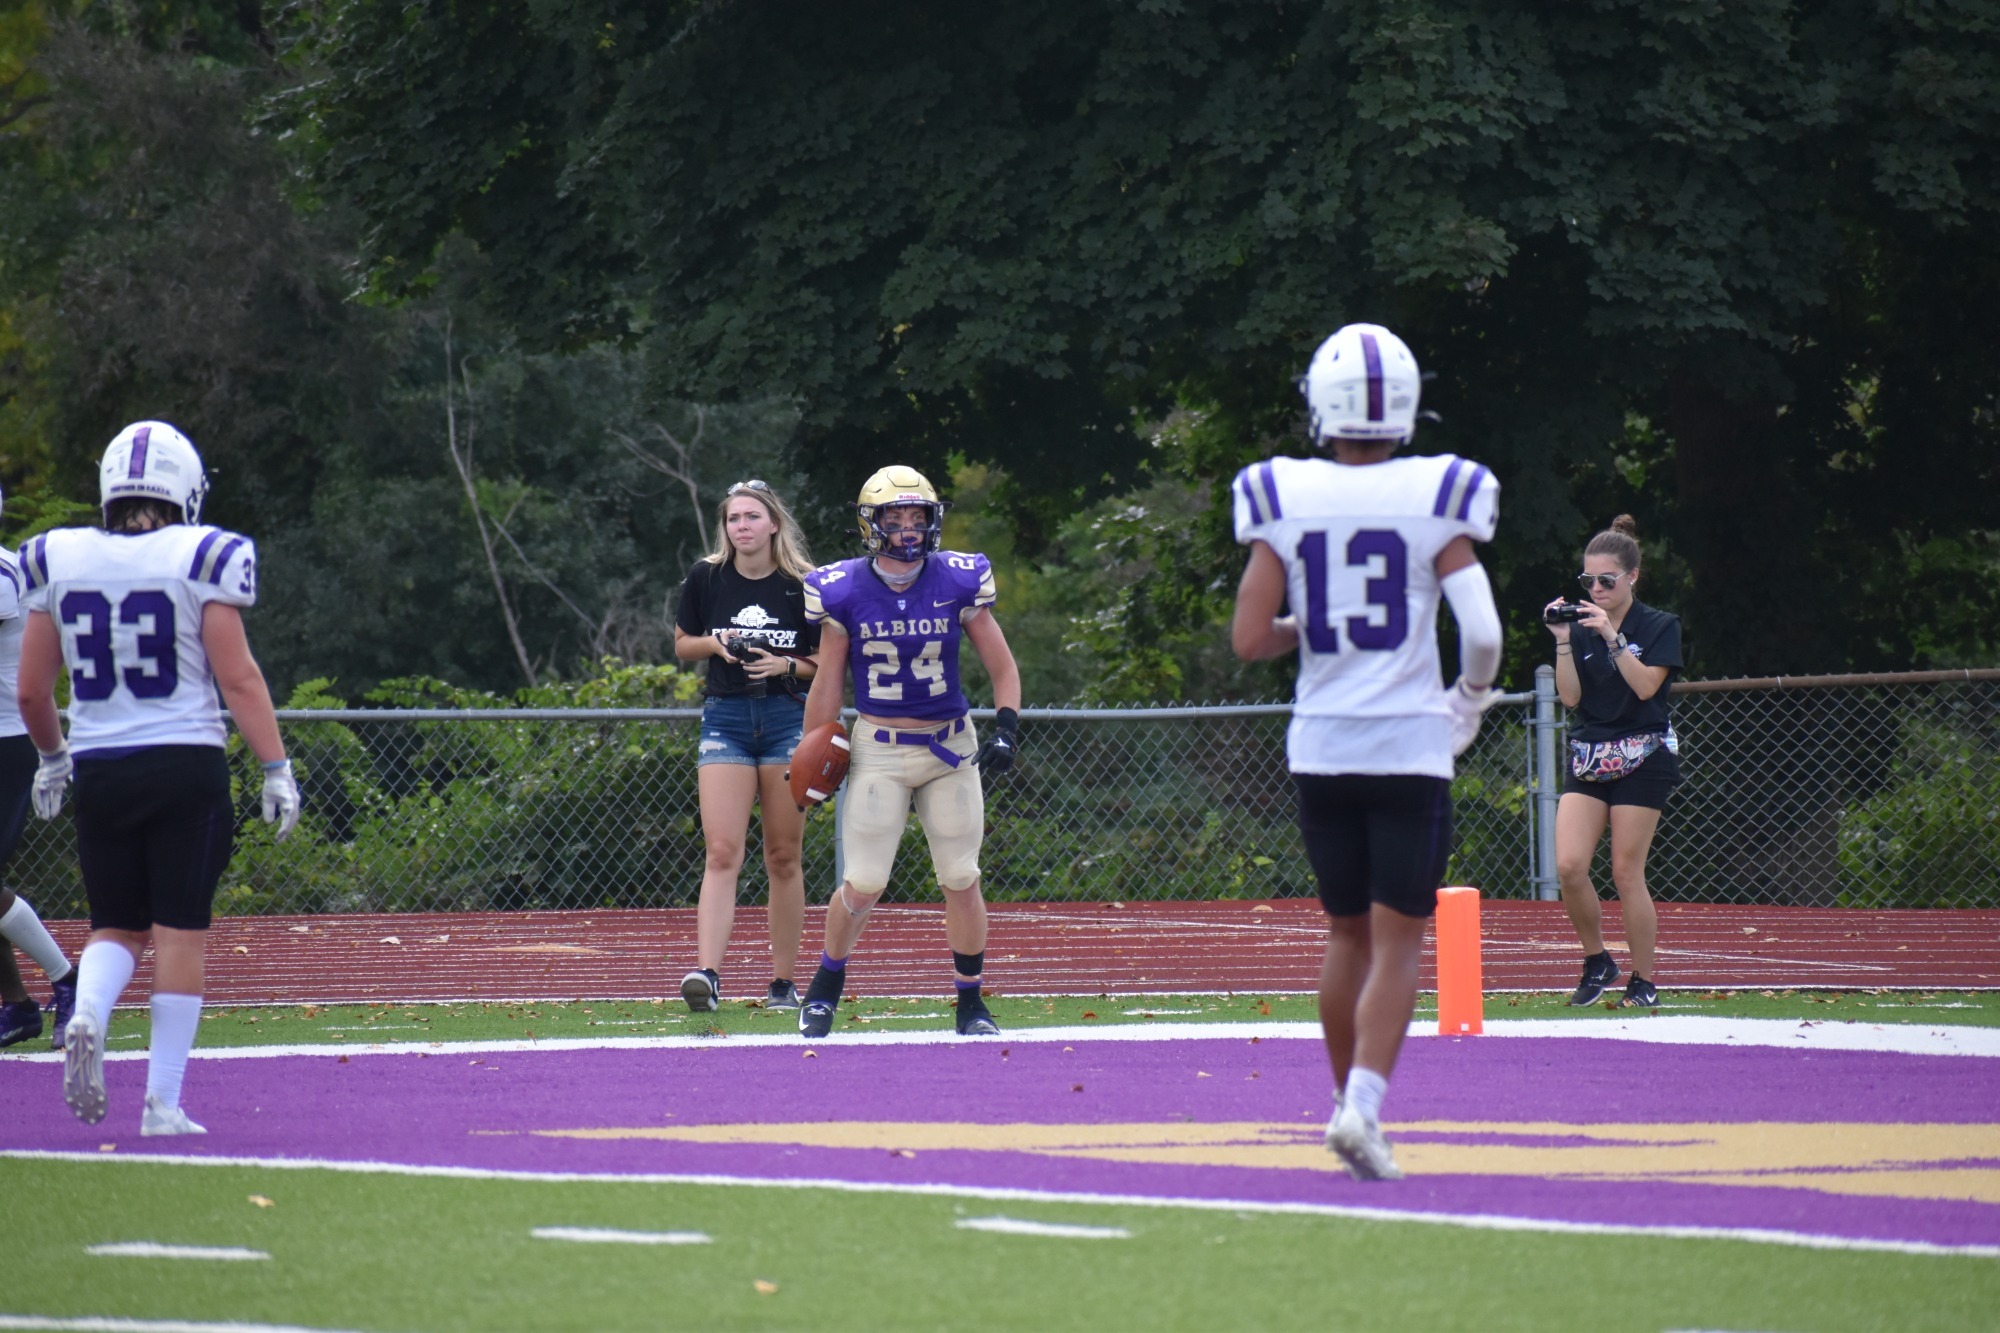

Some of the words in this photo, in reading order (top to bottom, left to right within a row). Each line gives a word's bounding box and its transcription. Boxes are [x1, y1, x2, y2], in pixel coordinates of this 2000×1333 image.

[948, 551, 975, 570] 2
[1296, 529, 1409, 654] 13
[59, 590, 179, 701] 33
[711, 628, 797, 639] BFFTON
[860, 618, 949, 639] ALBION
[862, 641, 947, 700] 24
